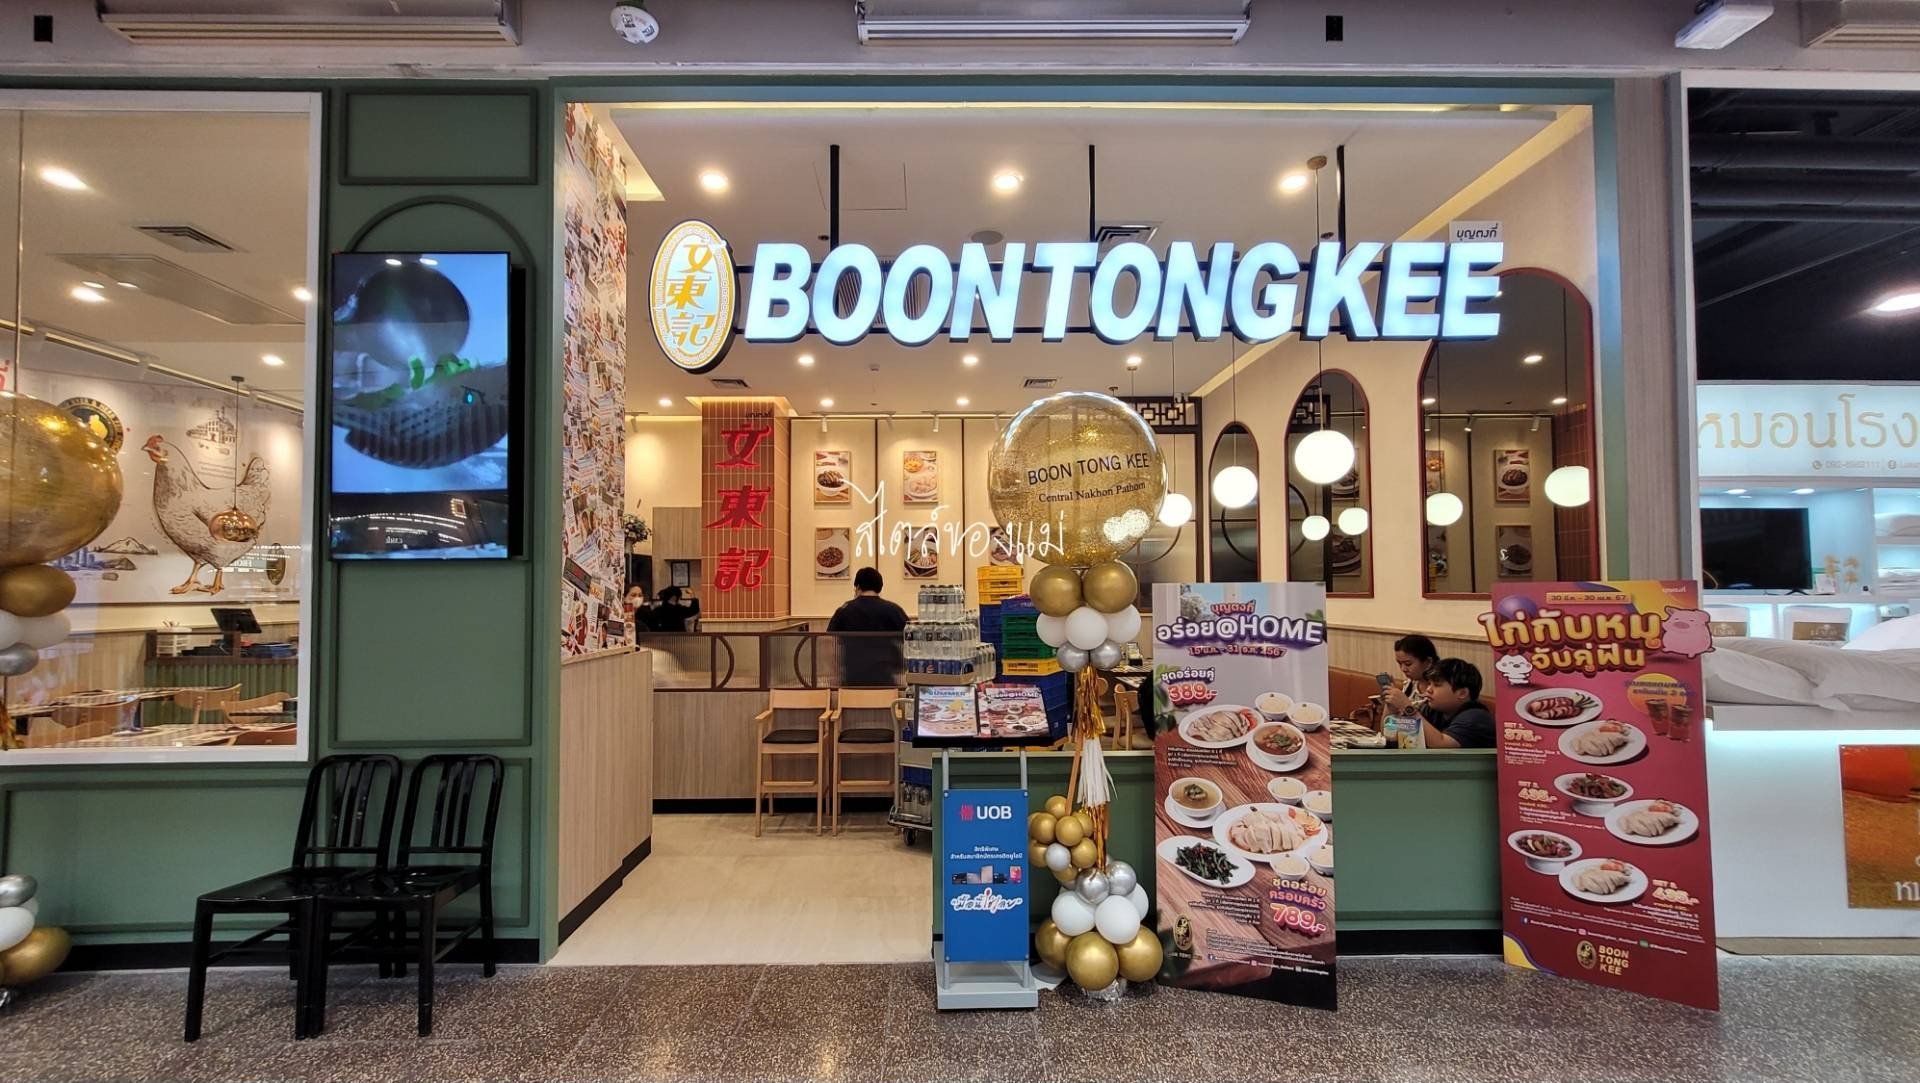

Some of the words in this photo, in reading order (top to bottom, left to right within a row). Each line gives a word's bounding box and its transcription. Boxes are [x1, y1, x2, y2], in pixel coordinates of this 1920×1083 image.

[1028, 463, 1072, 485] BOON
[1077, 455, 1121, 475] TONG
[1126, 453, 1150, 468] KEE
[1038, 492, 1073, 503] Central
[1076, 488, 1114, 500] Nakhon
[1116, 481, 1146, 494] Pathom
[706, 423, 772, 591] 文東記
[1211, 600, 1256, 614] บุญตงกี่
[1157, 615, 1323, 643] อร่อย@HOME
[1478, 609, 1662, 649] ไก่กับหมู
[1531, 643, 1645, 672] จับคู่ฟิน
[1161, 667, 1215, 683] ชุดอร่อยคู่
[976, 805, 1012, 820] UOB
[1272, 878, 1327, 897] ชุดอร่อย
[1598, 945, 1630, 959] BOON
[1599, 954, 1629, 968] TONG
[1599, 964, 1622, 976] KEE
